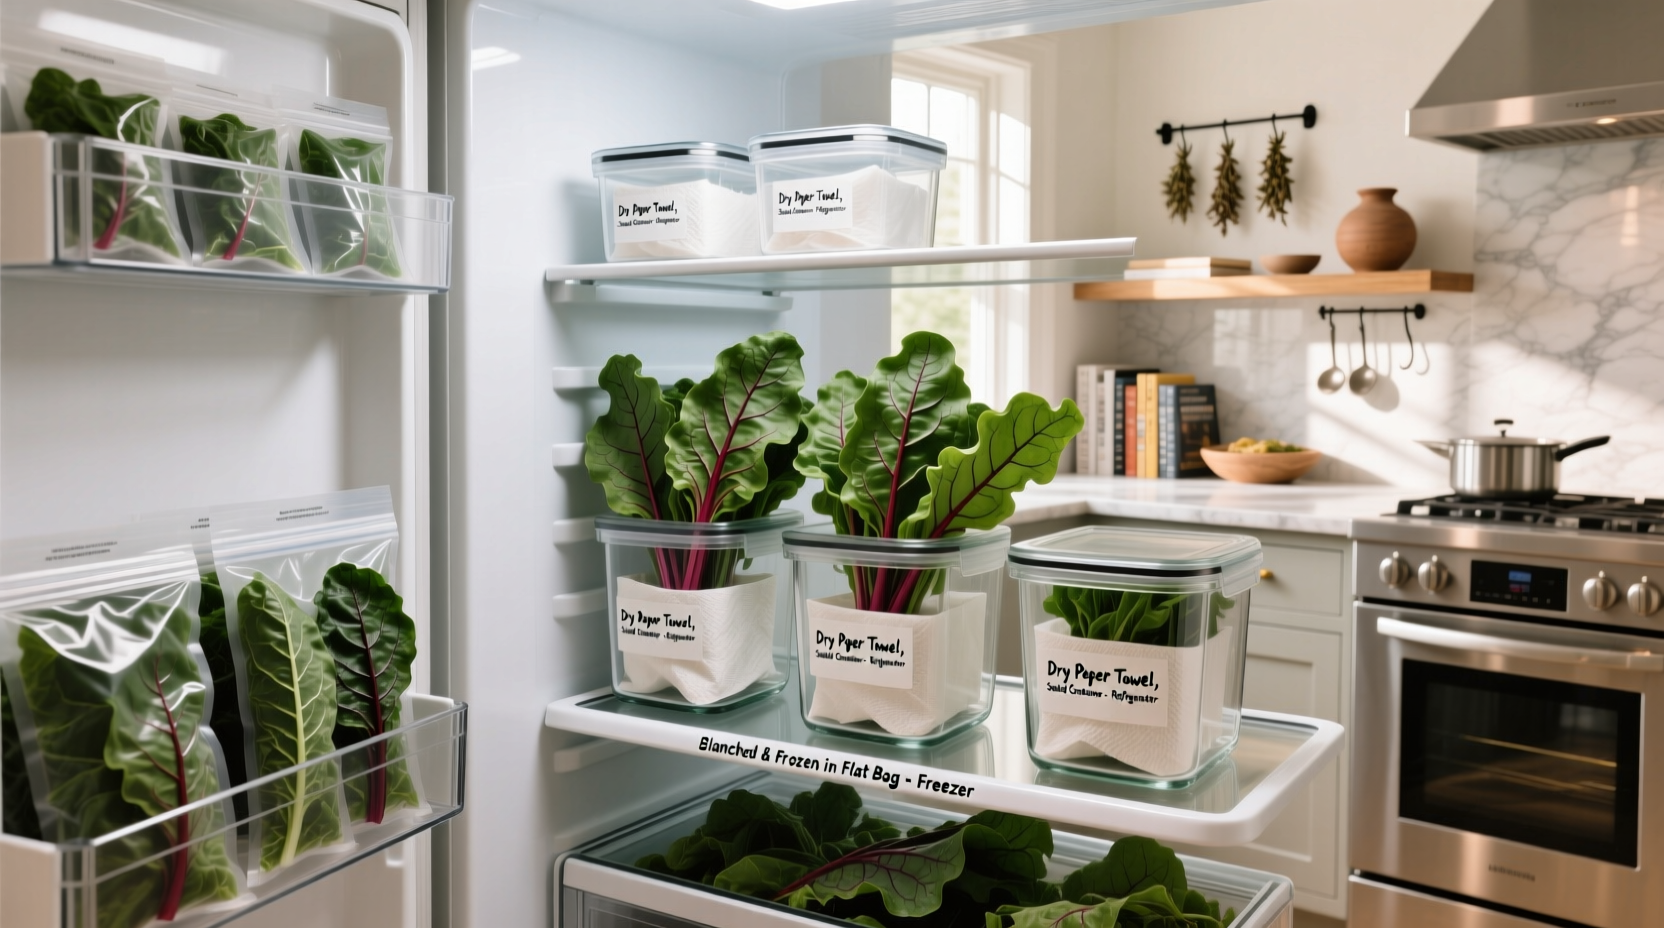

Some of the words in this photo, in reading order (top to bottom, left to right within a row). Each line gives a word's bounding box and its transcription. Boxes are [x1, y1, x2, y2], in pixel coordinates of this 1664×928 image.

[816, 629, 835, 651] Dry
[1047, 660, 1071, 684] Dry
[1114, 668, 1160, 691] Towel,
[761, 746, 771, 762] &
[774, 749, 819, 771] Frozen
[823, 757, 838, 774] in
[841, 760, 870, 779] Flat
[916, 773, 975, 798] Freezer
